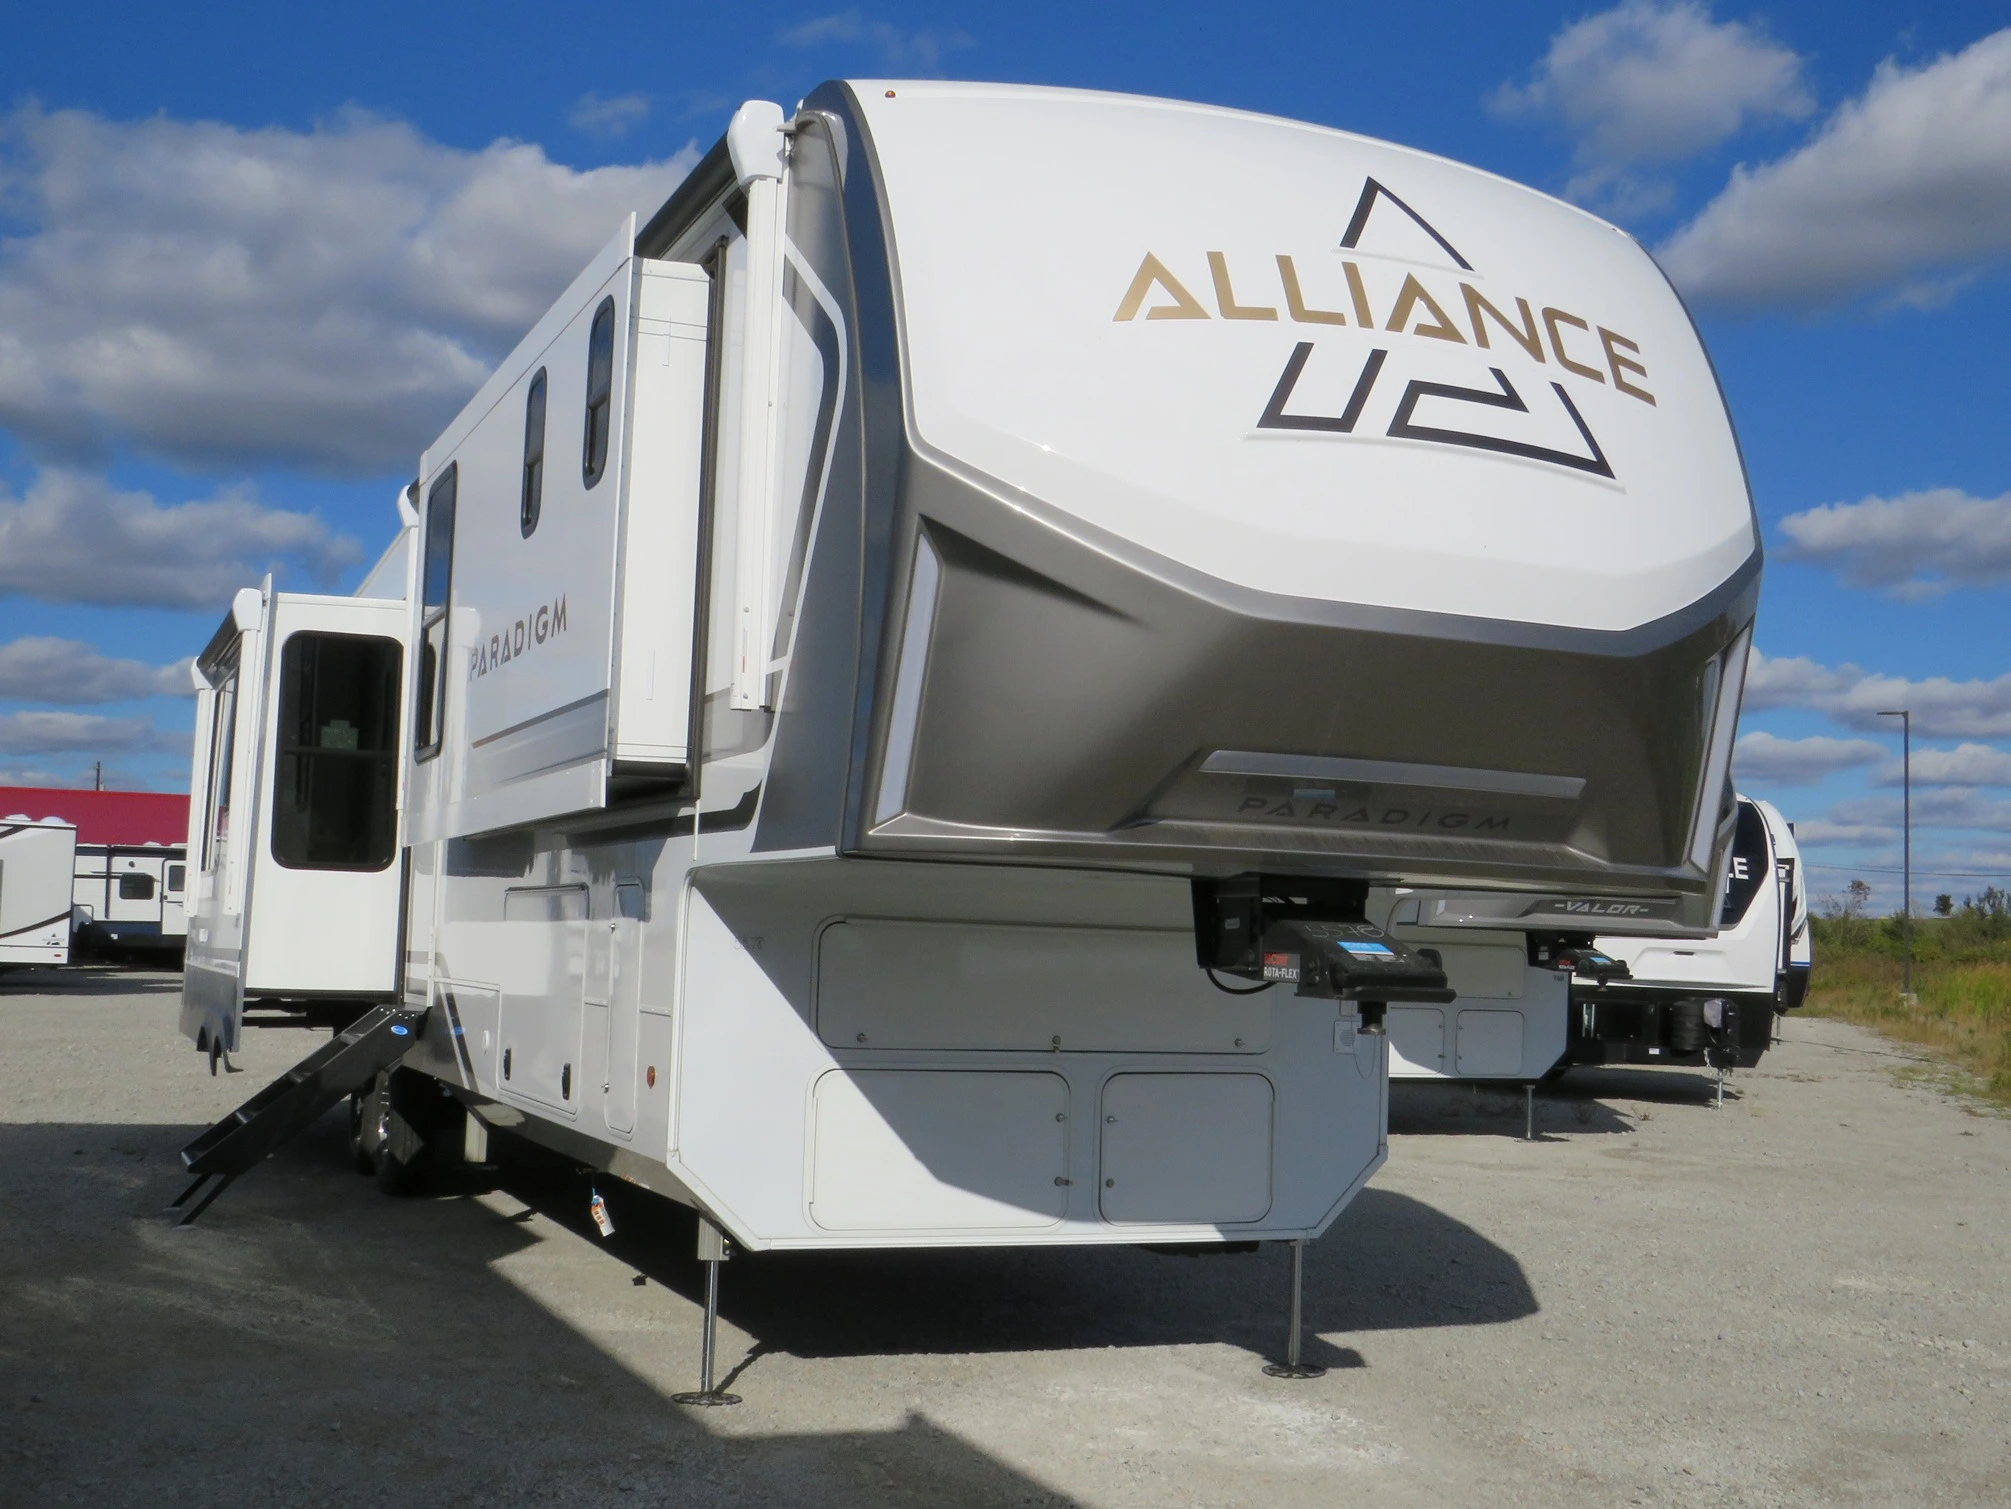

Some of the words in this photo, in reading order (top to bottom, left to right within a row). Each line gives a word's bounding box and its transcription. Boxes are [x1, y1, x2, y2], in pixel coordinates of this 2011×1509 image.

[1112, 251, 1657, 406] ALLIANCE
[470, 593, 567, 681] PARADIGM
[1239, 798, 1511, 830] PARADIGM
